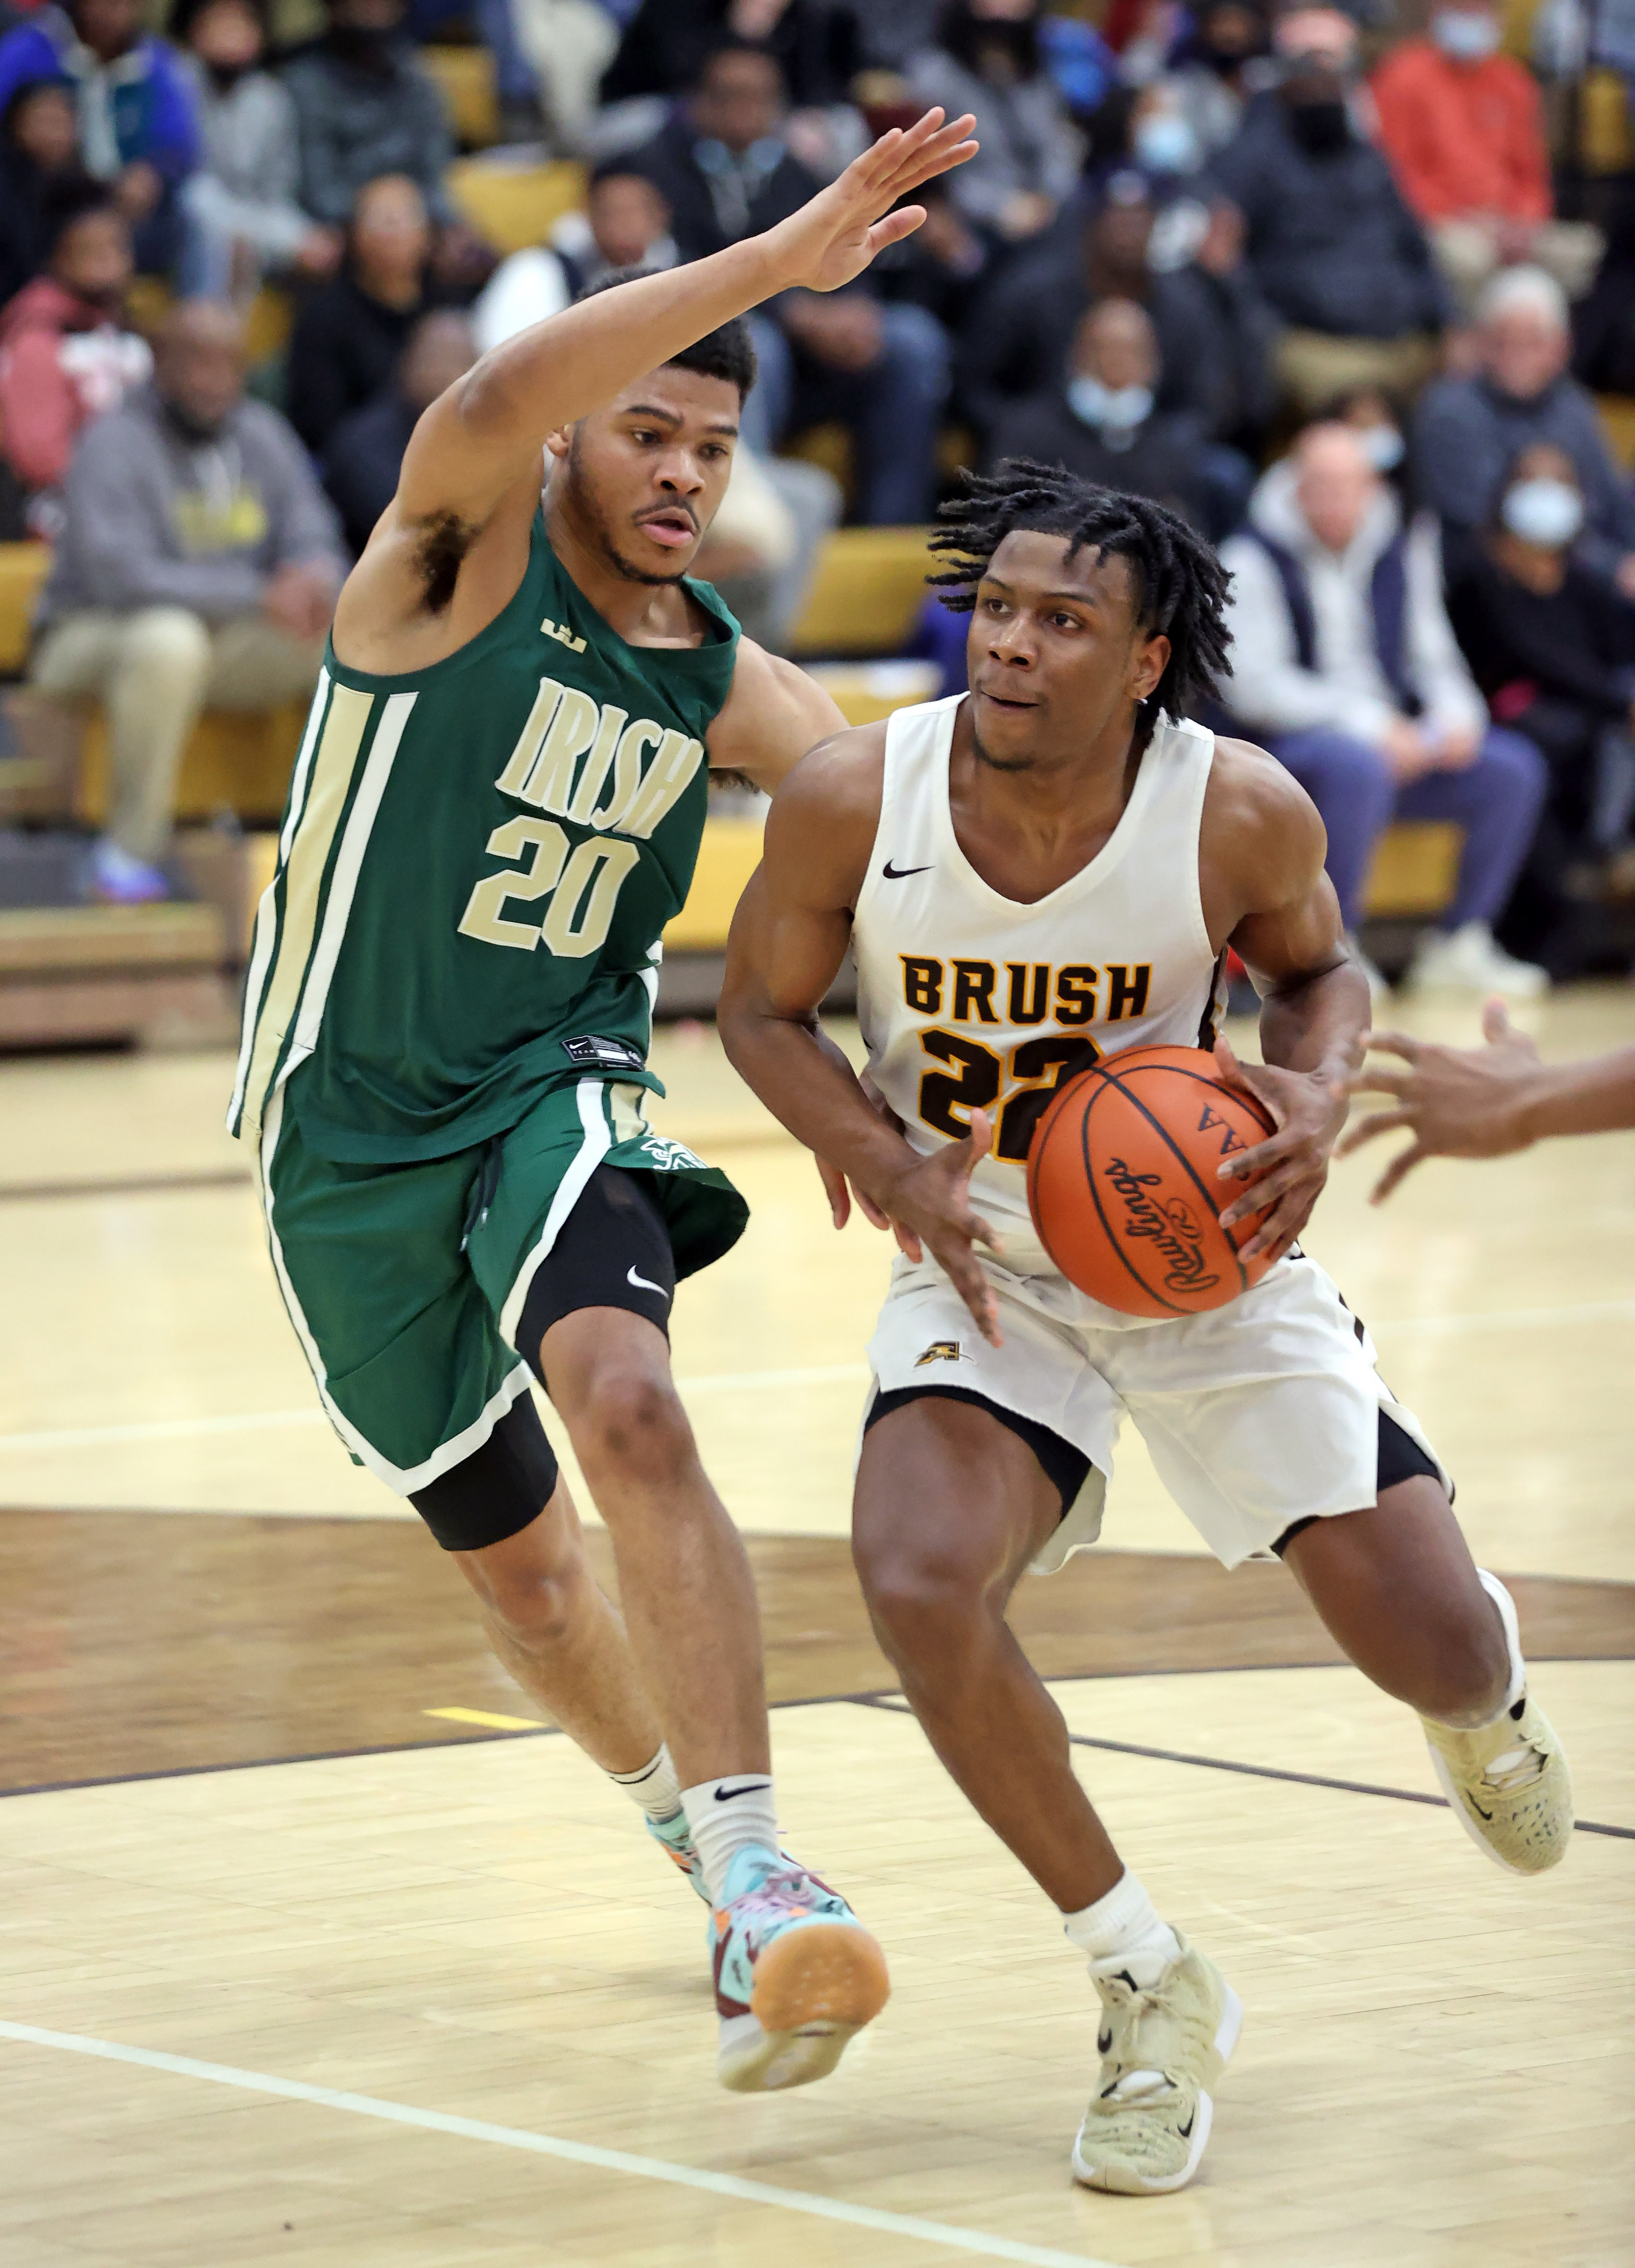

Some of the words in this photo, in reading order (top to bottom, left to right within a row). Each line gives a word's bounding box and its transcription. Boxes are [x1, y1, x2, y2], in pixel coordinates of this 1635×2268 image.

[494, 677, 705, 840] IRISH
[457, 815, 641, 958] 20
[898, 952, 1152, 1027] BRUSH
[917, 1025, 1105, 1165] 22
[1105, 1157, 1219, 1293] Rawlings
